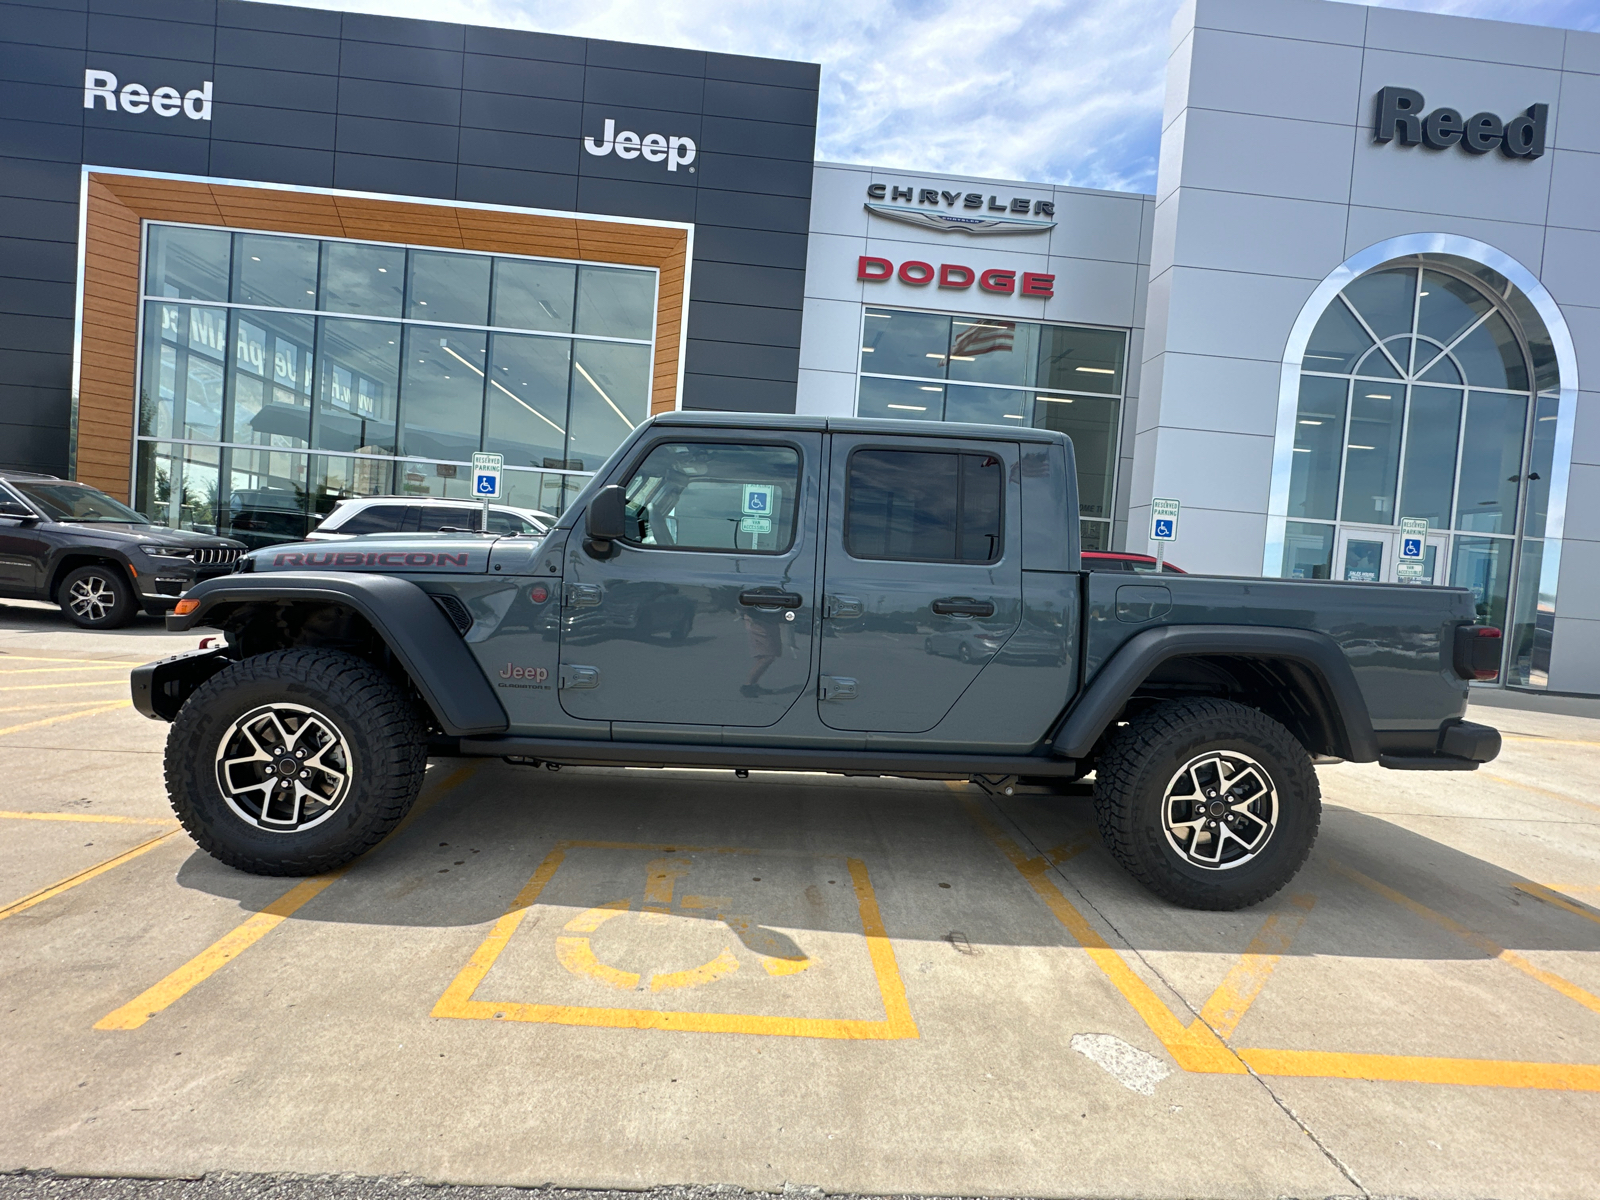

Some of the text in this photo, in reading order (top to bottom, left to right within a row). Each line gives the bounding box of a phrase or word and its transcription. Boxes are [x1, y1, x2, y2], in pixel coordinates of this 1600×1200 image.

[84, 69, 213, 120] Reed
[1373, 86, 1549, 160] Reed
[584, 118, 696, 172] Jeep
[867, 183, 1055, 216] CHRYSLER
[857, 255, 1055, 299] DODGE
[475, 456, 501, 465] RESERVED
[475, 464, 500, 472] PARKING
[1154, 501, 1178, 509] RESERVED
[1153, 509, 1177, 517] PARKING
[1403, 521, 1426, 529] RESERVED
[1402, 528, 1425, 536] PARKING
[273, 552, 469, 567] RUBICON
[499, 662, 548, 683] Jeep
[498, 682, 543, 690] GLADIATOR
